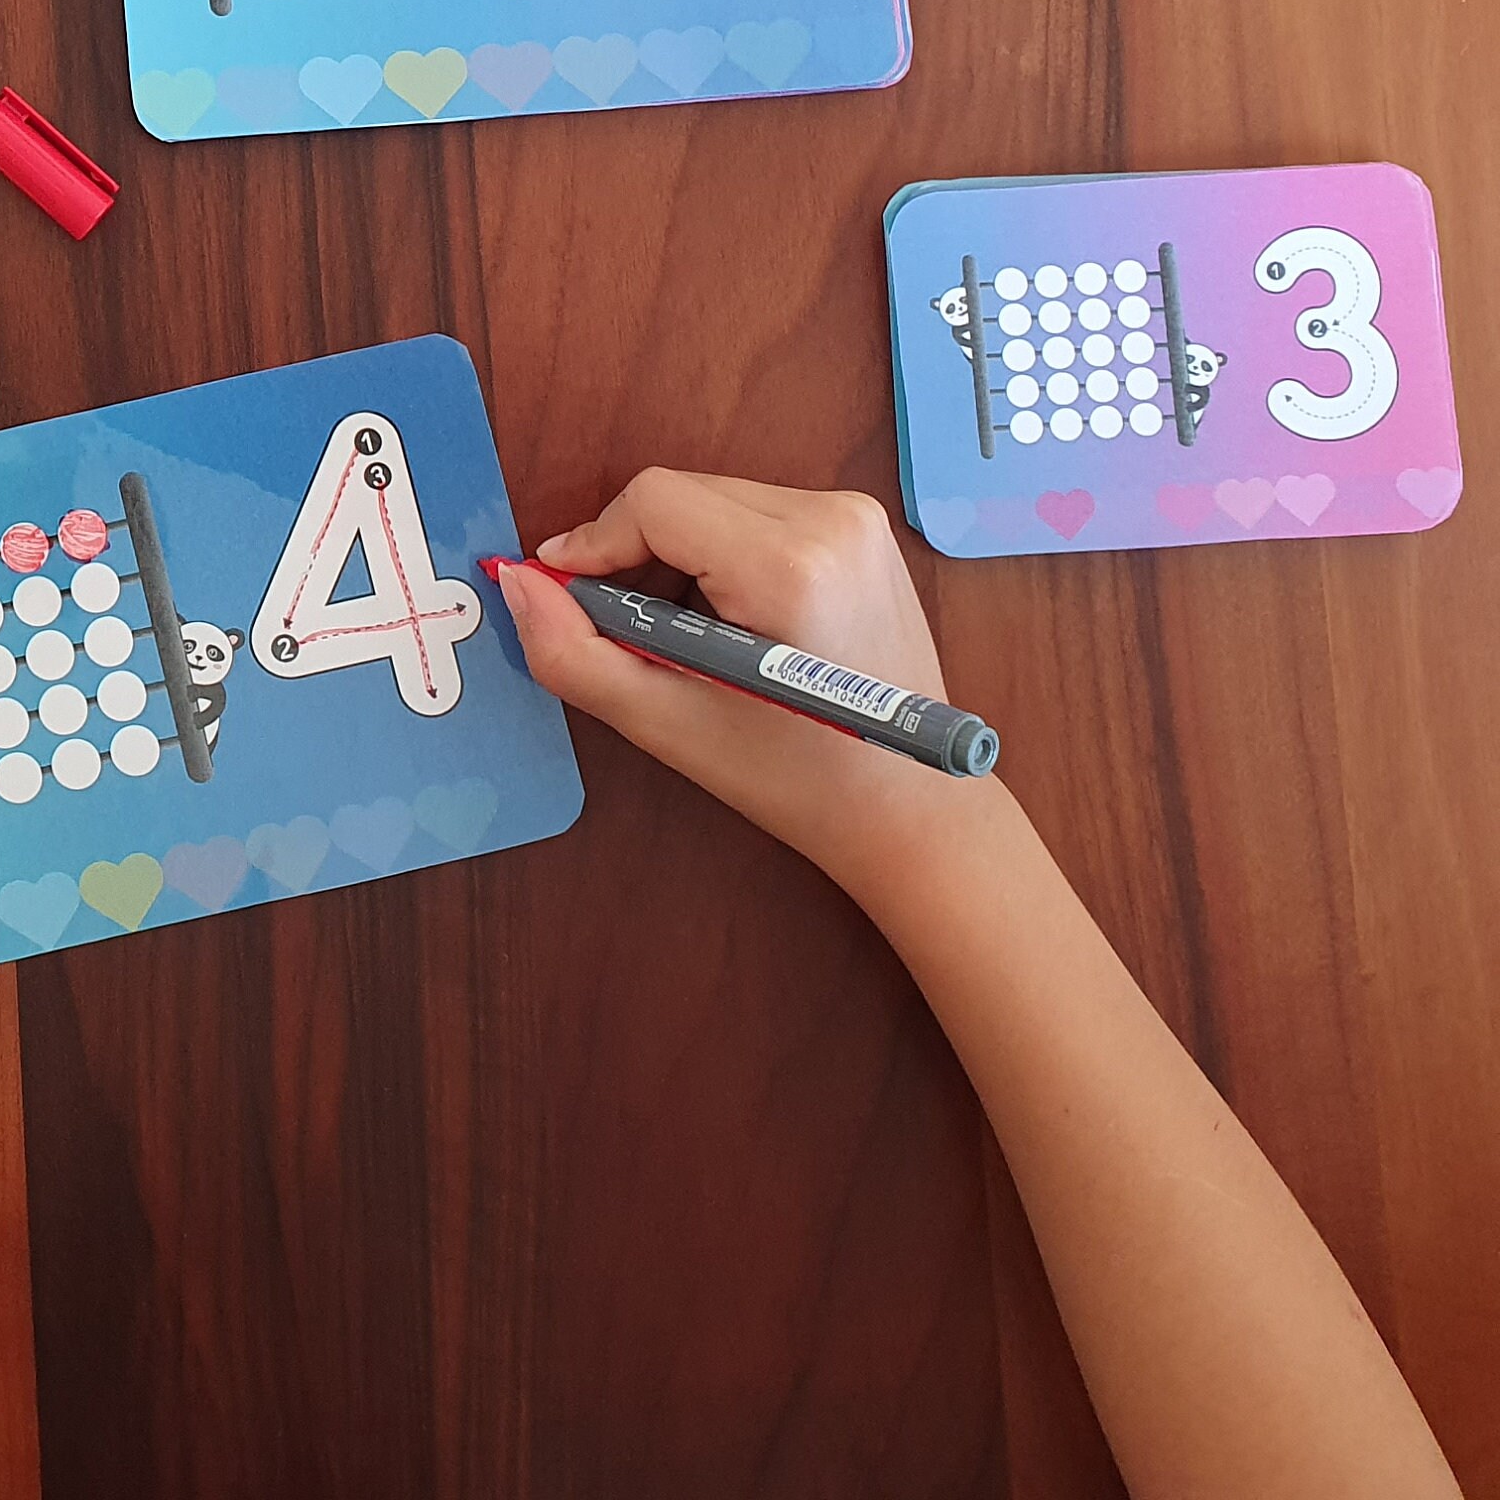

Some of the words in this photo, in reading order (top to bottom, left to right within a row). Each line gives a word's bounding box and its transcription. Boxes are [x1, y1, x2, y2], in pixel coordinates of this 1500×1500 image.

[1254, 225, 1400, 442] 3
[1311, 319, 1325, 337] 2
[361, 431, 373, 452] 1
[371, 465, 386, 487] 3
[249, 411, 482, 717] 4
[277, 638, 294, 660] 2
[767, 663, 775, 675] 4
